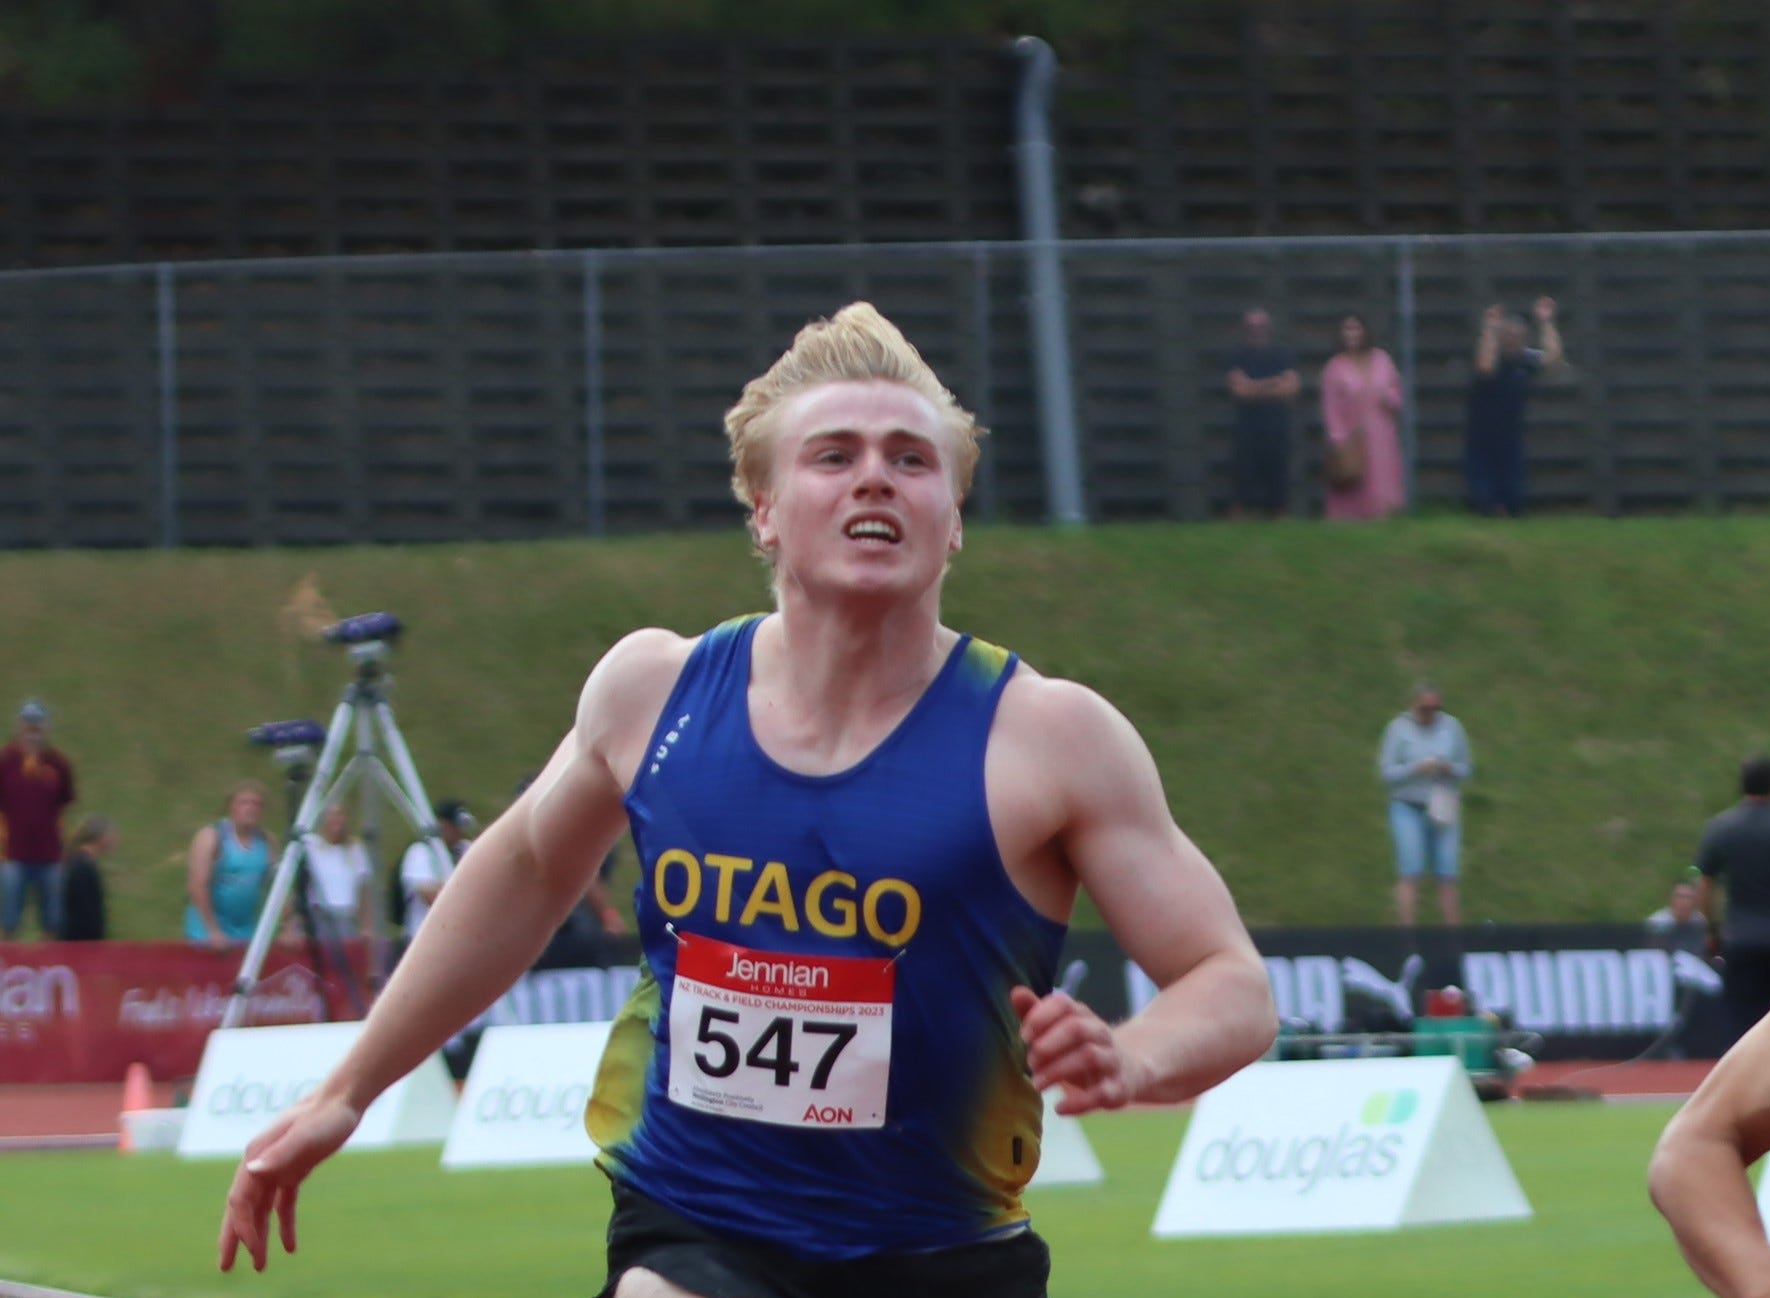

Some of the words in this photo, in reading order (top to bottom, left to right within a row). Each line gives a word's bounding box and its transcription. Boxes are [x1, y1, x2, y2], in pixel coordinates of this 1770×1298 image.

[654, 848, 922, 947] OTAGO
[726, 952, 829, 988] Jennian
[732, 994, 762, 1007] FIELD
[1462, 948, 1676, 1032] PUMA
[694, 1004, 859, 1090] 547
[1196, 1122, 1404, 1195] douglas
